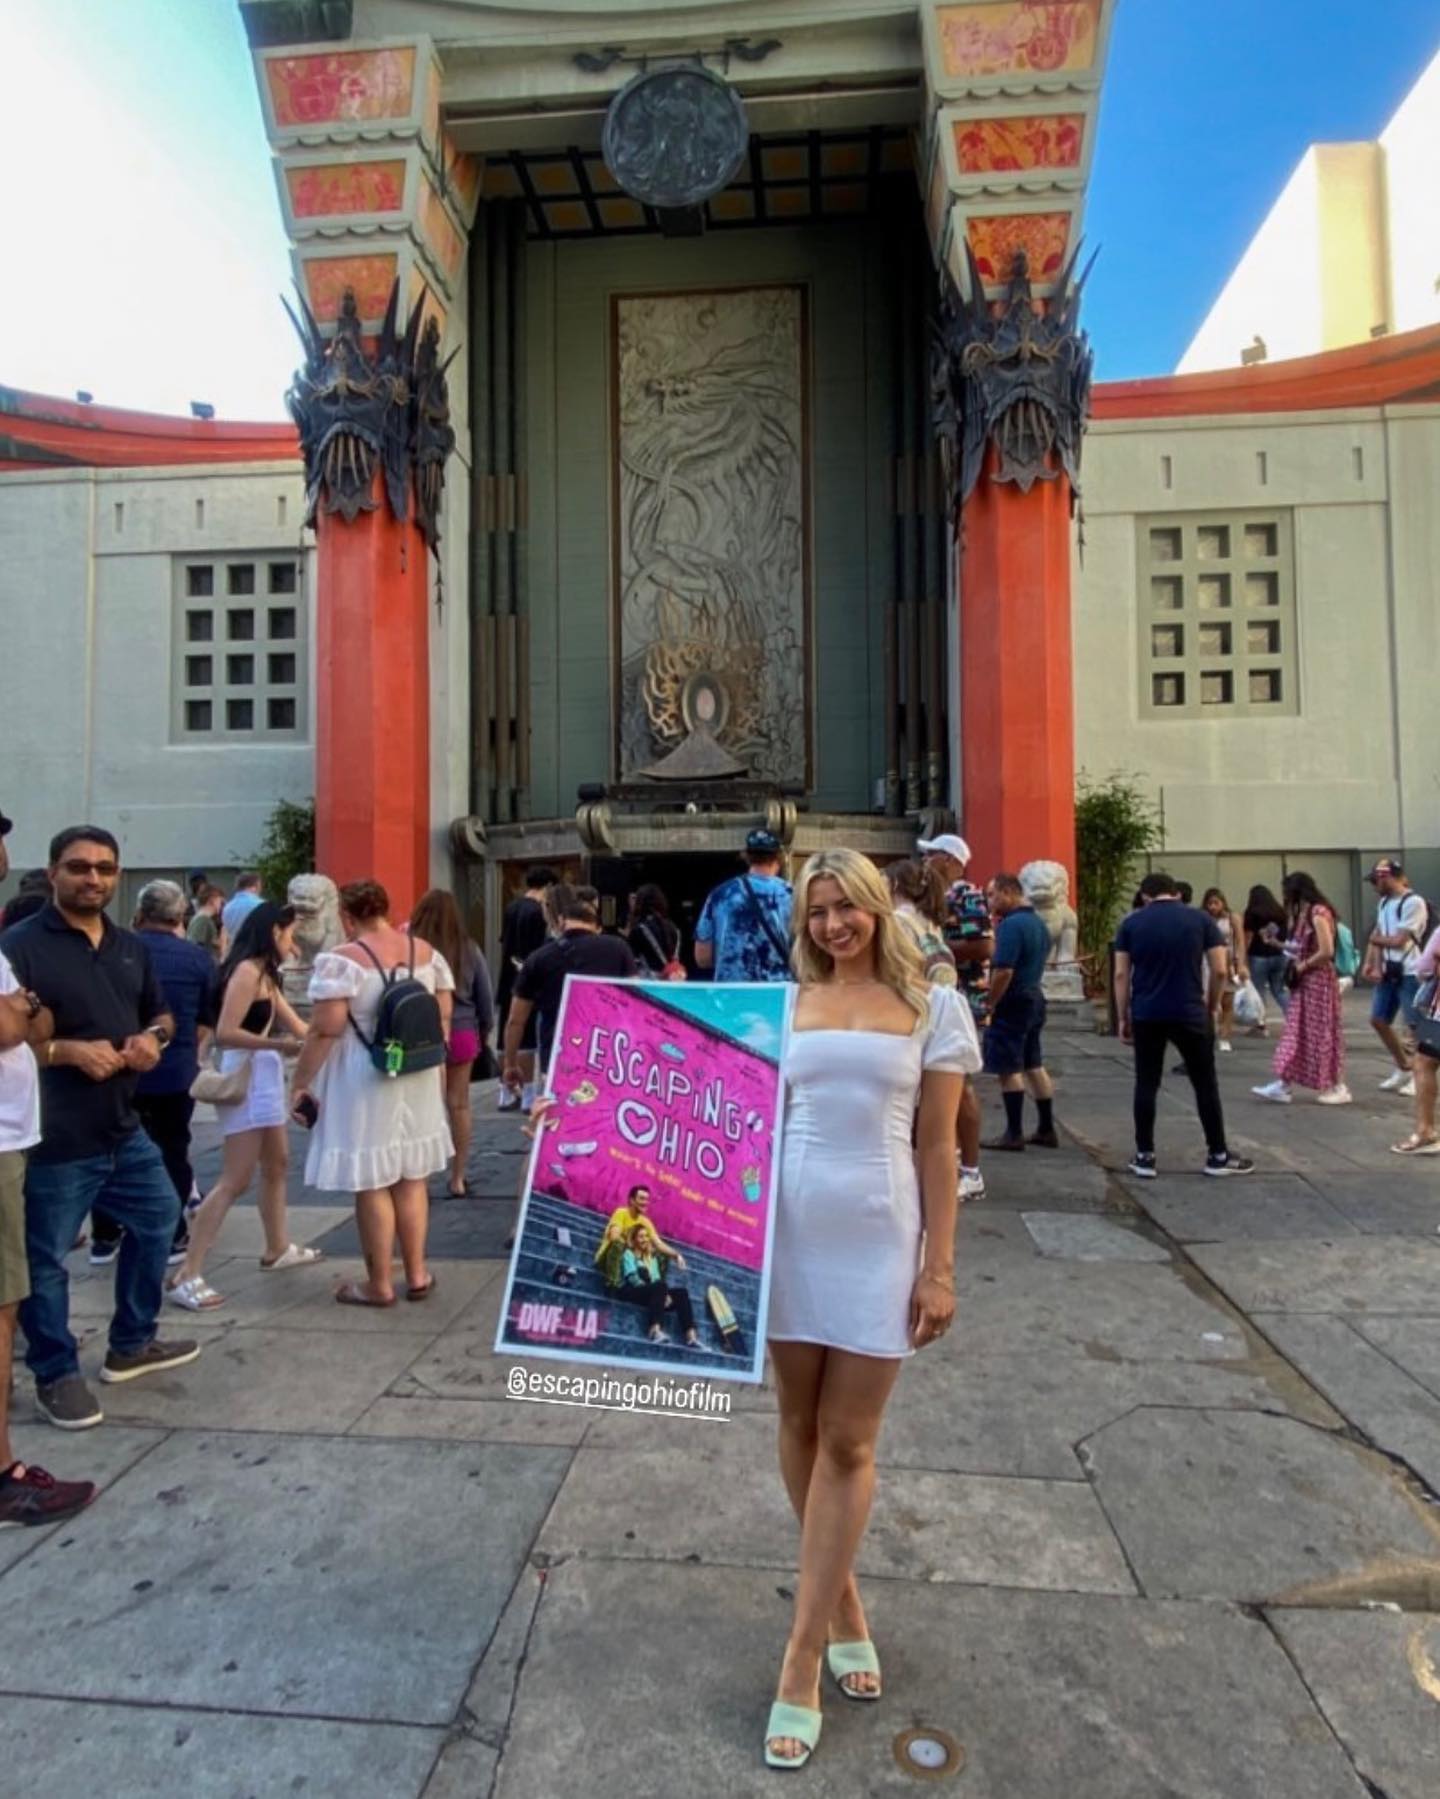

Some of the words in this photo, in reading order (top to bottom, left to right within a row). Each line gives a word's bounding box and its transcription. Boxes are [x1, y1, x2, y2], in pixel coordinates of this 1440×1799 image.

[587, 1026, 742, 1140] ESCAPING
[616, 1100, 724, 1179] OHIO
[517, 1303, 564, 1335] DWF
[574, 1308, 599, 1339] LA
